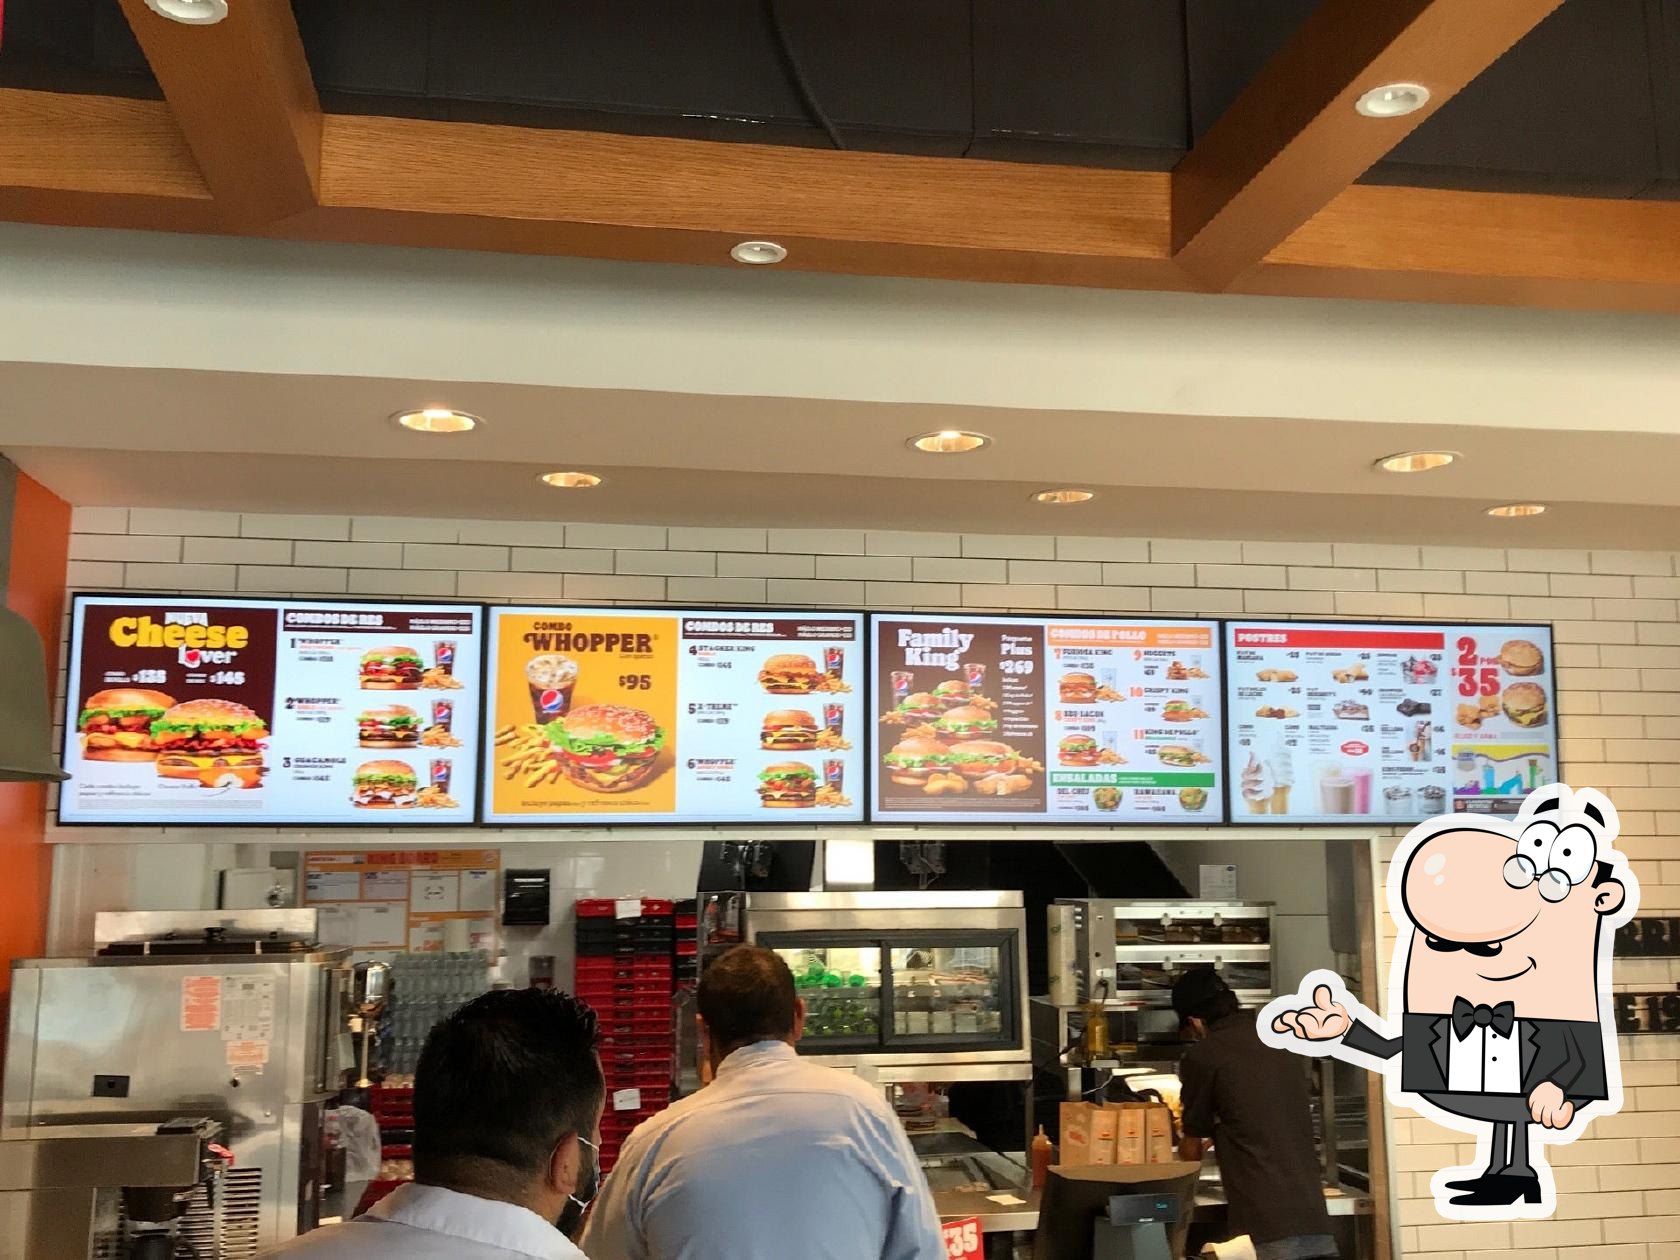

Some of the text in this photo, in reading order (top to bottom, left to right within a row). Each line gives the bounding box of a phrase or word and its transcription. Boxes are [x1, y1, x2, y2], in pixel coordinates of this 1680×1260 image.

[109, 616, 249, 648] Cheese
[533, 622, 572, 631] COMBO
[684, 621, 735, 633] COMBOS
[734, 622, 751, 633] DE
[290, 638, 296, 649] 1
[523, 632, 653, 653] WHOPPER
[897, 627, 975, 654] Family
[1237, 633, 1288, 644] POSTRES
[688, 645, 698, 656] 4
[1456, 636, 1478, 666] 2
[904, 646, 960, 672] King
[618, 674, 652, 691] $95
[1451, 667, 1501, 697] $35
[285, 697, 295, 710] 2
[688, 703, 697, 715] 5
[282, 757, 292, 769] 3
[687, 758, 696, 769] 6
[1052, 773, 1118, 784] ENSALADAS
